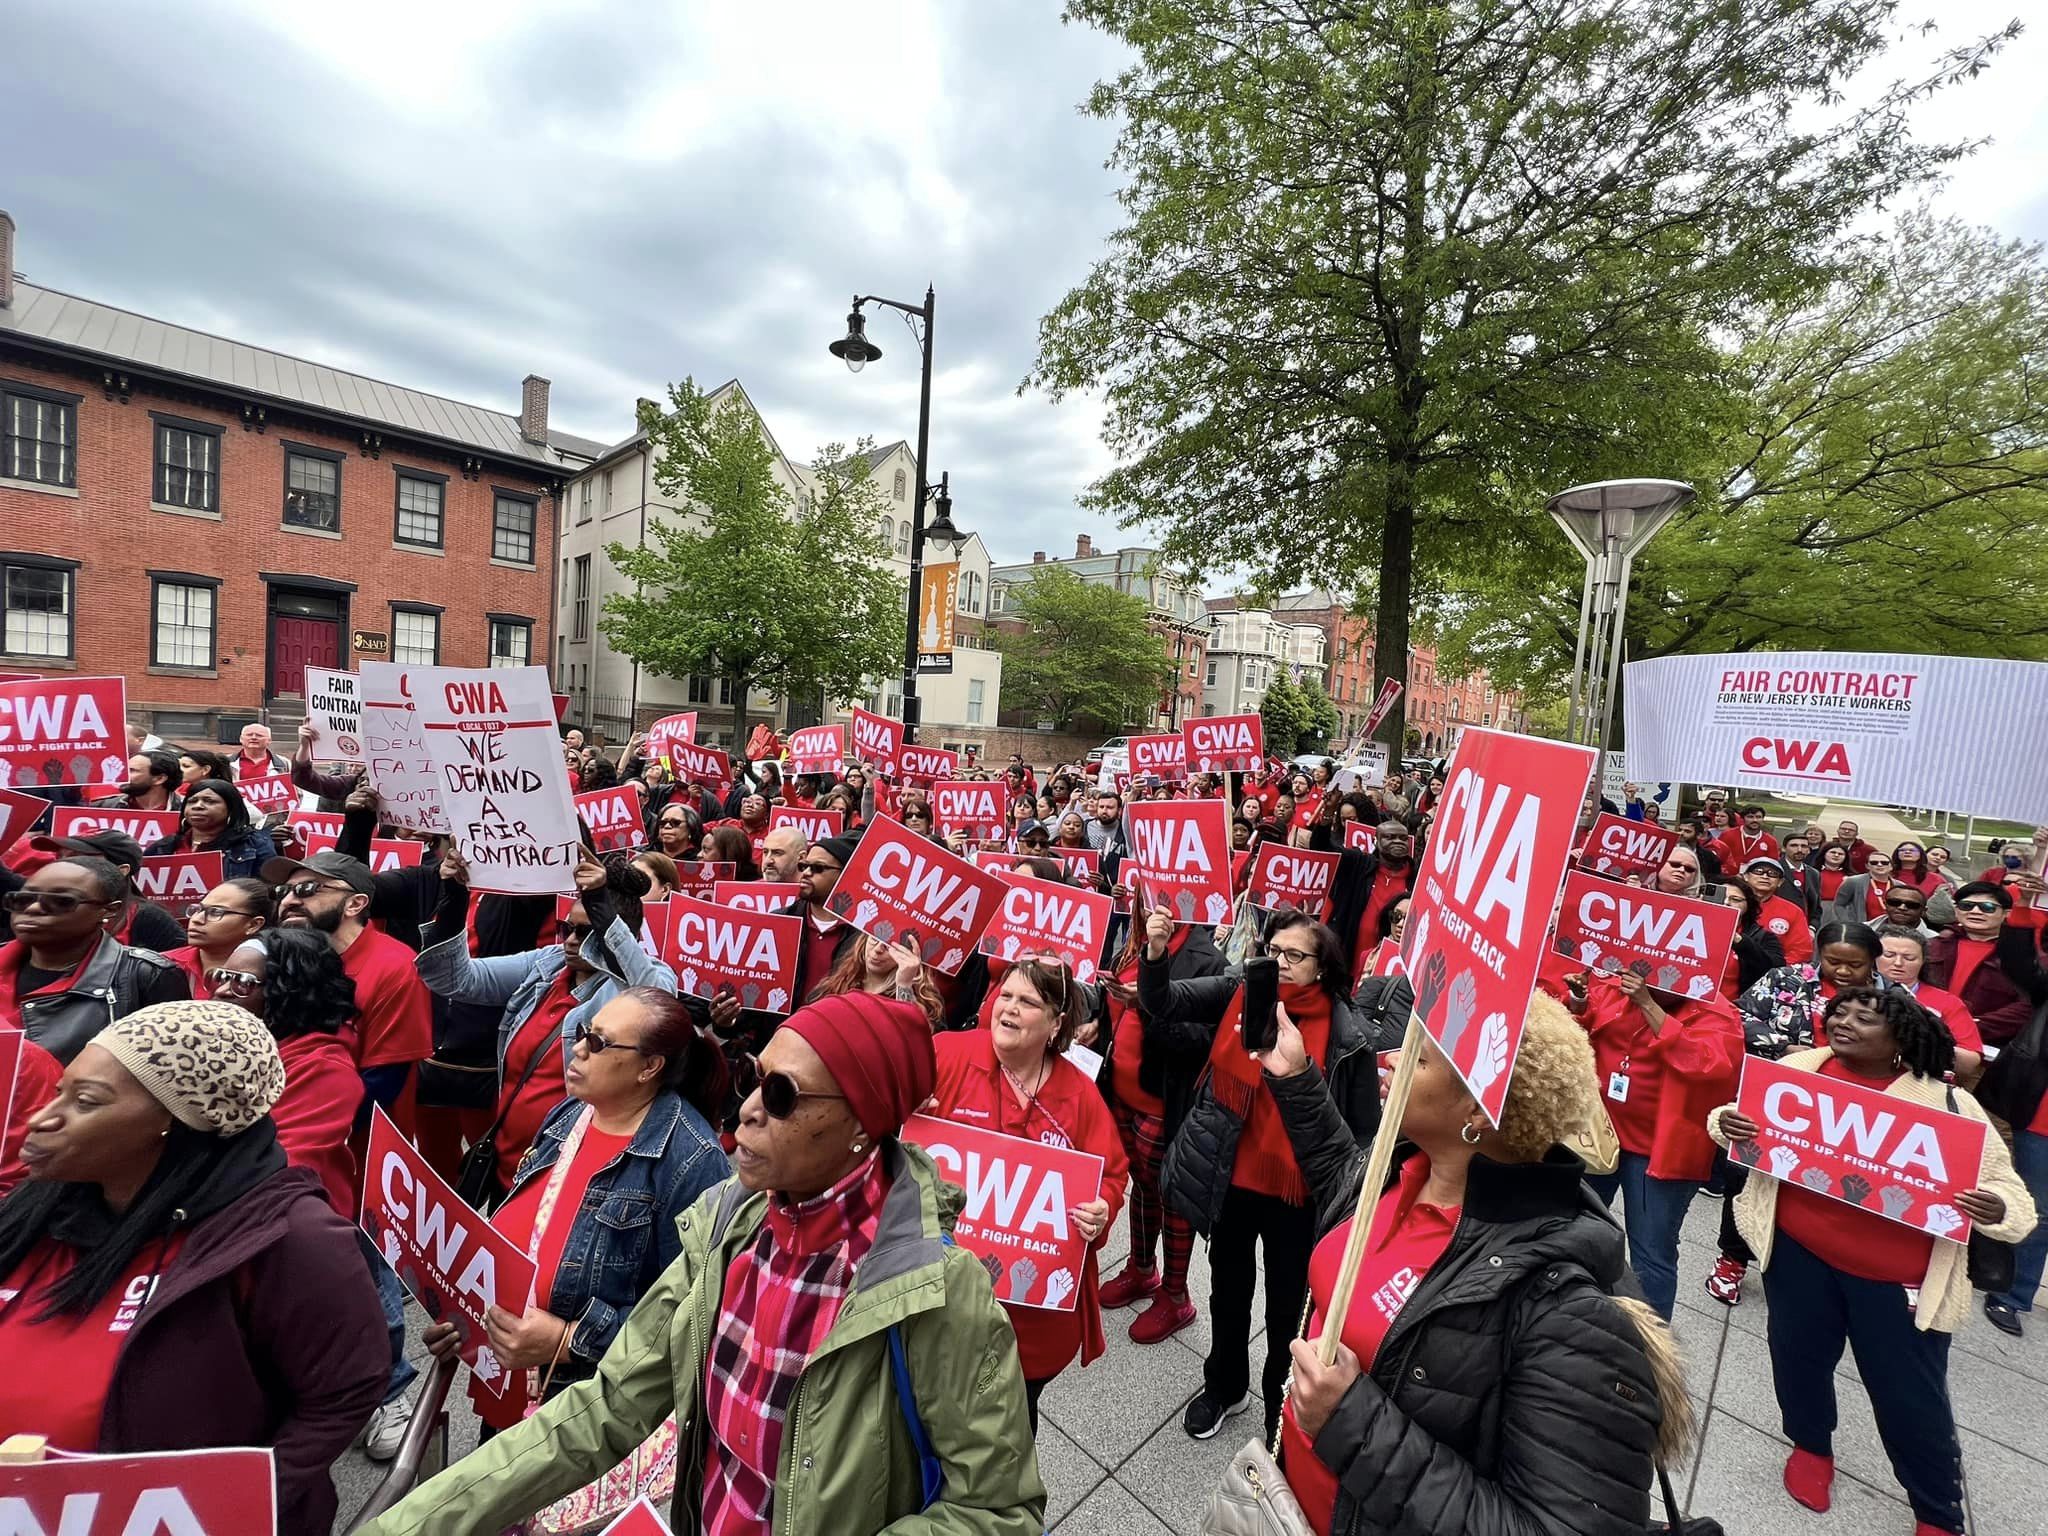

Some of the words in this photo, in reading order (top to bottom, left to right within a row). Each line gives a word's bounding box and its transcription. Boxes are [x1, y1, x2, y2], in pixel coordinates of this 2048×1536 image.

[944, 571, 957, 648] HISTORY
[328, 677, 353, 694] FAIR
[444, 682, 508, 715] CWA
[1720, 671, 1771, 692] FAIR
[1777, 671, 1917, 699] CONTRACT
[312, 694, 360, 715] CONTRA
[1717, 693, 1738, 703] FOR
[1739, 693, 1764, 704] NEW
[1766, 694, 1808, 705] JERSEY
[1810, 695, 1847, 708] STATE
[1849, 697, 1912, 712] WORKERS
[329, 716, 356, 733] NOW
[462, 723, 482, 731] LOCAL
[650, 719, 689, 740] CWA
[855, 716, 893, 752] CWA
[1193, 723, 1254, 750] CWA
[39, 742, 72, 751] FIGHT
[456, 731, 508, 765] WE
[793, 732, 837, 754] CWA
[1743, 736, 1851, 776] CWA
[372, 758, 436, 778] FAI
[673, 744, 723, 775] CWA
[901, 752, 950, 775] CWA
[1609, 755, 1624, 768] NE
[445, 764, 542, 794] DEMAND
[482, 796, 505, 822] A
[576, 796, 632, 829] WA
[939, 790, 997, 816] CWA
[469, 821, 536, 842] FAIR
[1135, 819, 1212, 871] CWA
[1602, 825, 1667, 863] CWA
[459, 838, 578, 868] CONTRACT
[869, 841, 981, 932] CWA
[1180, 873, 1210, 884] BACK.
[1266, 855, 1329, 889] CWA
[862, 882, 892, 903] STAND
[893, 899, 908, 914] UP.
[911, 911, 938, 931] FIGHT
[939, 924, 962, 941] BACK.
[1004, 886, 1092, 944] CWA
[1579, 891, 1708, 959] CWA
[678, 912, 780, 971] CWA
[1002, 923, 1027, 935] STAND
[1029, 929, 1042, 938] UP.
[1044, 934, 1066, 946] FIGHT
[1067, 939, 1087, 952] BACK.
[1440, 904, 1472, 944] FIGHT
[1471, 932, 1506, 980] BACK.
[1578, 928, 1610, 943] STAND
[1613, 938, 1630, 950] UP.
[1633, 944, 1666, 958] FIGHT
[1668, 953, 1701, 967] BACK.
[678, 953, 702, 967] STAND
[704, 959, 718, 972] UP.
[720, 965, 745, 977] FIGHT
[748, 970, 776, 981] BACK.
[1040, 1131, 1067, 1149] CWA
[1763, 1081, 1949, 1183] CWA
[1765, 1128, 1810, 1150] STAND
[1813, 1143, 1839, 1160] UP.
[1843, 1153, 1888, 1176] FIGHT
[1892, 1171, 1941, 1194] BACK.
[381, 1150, 497, 1309] CWA
[981, 1229, 1020, 1246] FIGHT
[1023, 1238, 1061, 1256] BACK.
[381, 1204, 408, 1245] STAND
[409, 1239, 424, 1265] UP.
[427, 1262, 455, 1299] FIGHT
